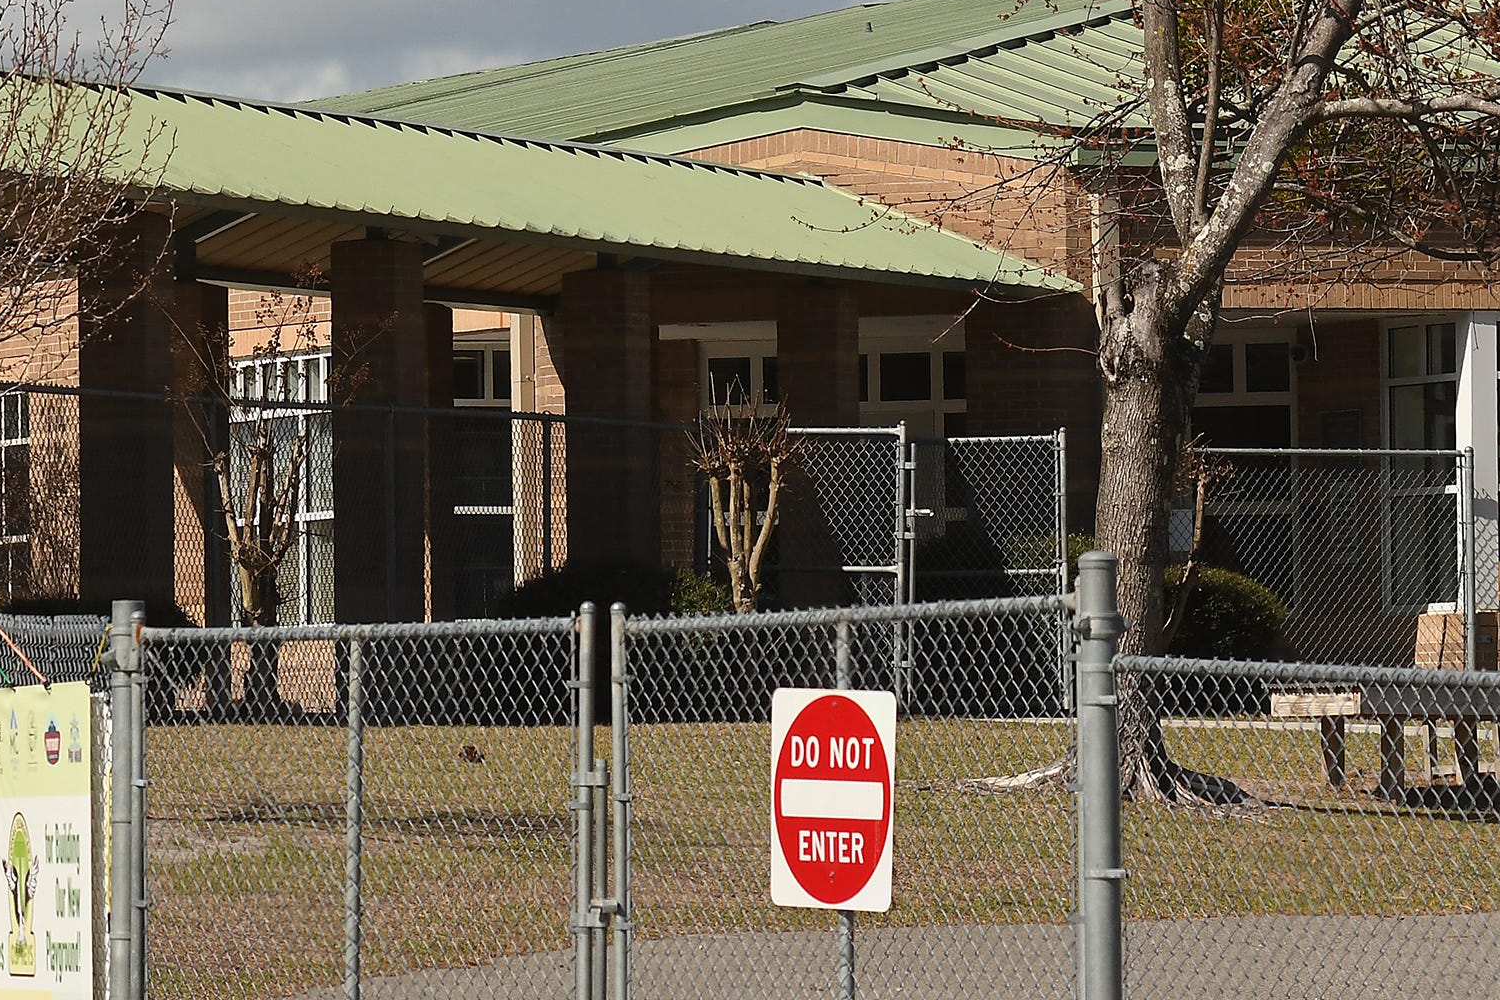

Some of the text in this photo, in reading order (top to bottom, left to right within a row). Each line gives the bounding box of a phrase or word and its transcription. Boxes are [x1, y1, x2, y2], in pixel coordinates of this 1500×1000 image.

[791, 735, 874, 770] DO NOT
[45, 824, 80, 875] for Building
[798, 830, 864, 864] ENTER
[55, 877, 81, 918] Our New
